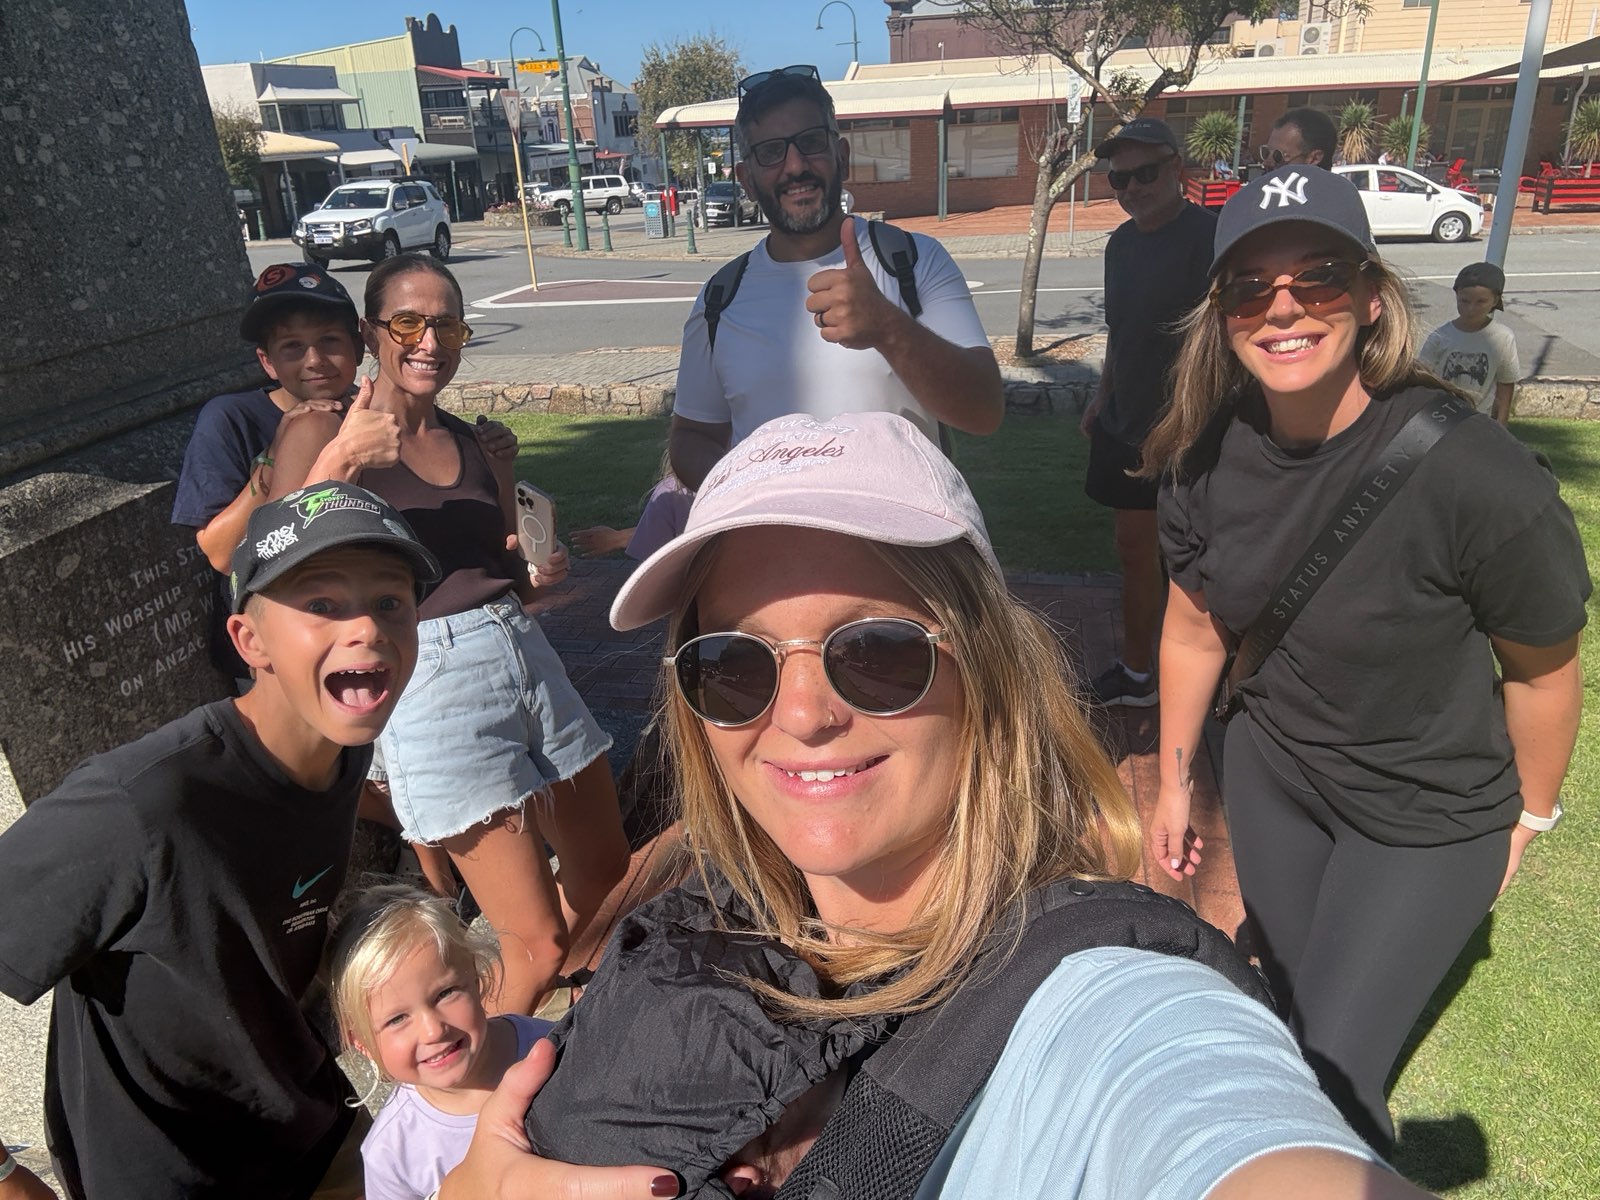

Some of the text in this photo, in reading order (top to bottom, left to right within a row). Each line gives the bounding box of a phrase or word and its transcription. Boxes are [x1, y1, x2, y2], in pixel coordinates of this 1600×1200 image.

[1259, 171, 1309, 210] NY
[736, 437, 846, 471] Angeles
[323, 499, 379, 512] THUNDER
[256, 522, 295, 549] SYDNEY
[257, 533, 299, 560] THUNDER
[129, 560, 170, 588] THIS
[1273, 552, 1328, 619] STATUS
[62, 634, 97, 665] HIS
[104, 586, 182, 657] WORSHIP
[120, 636, 206, 697] ON ANZAC
